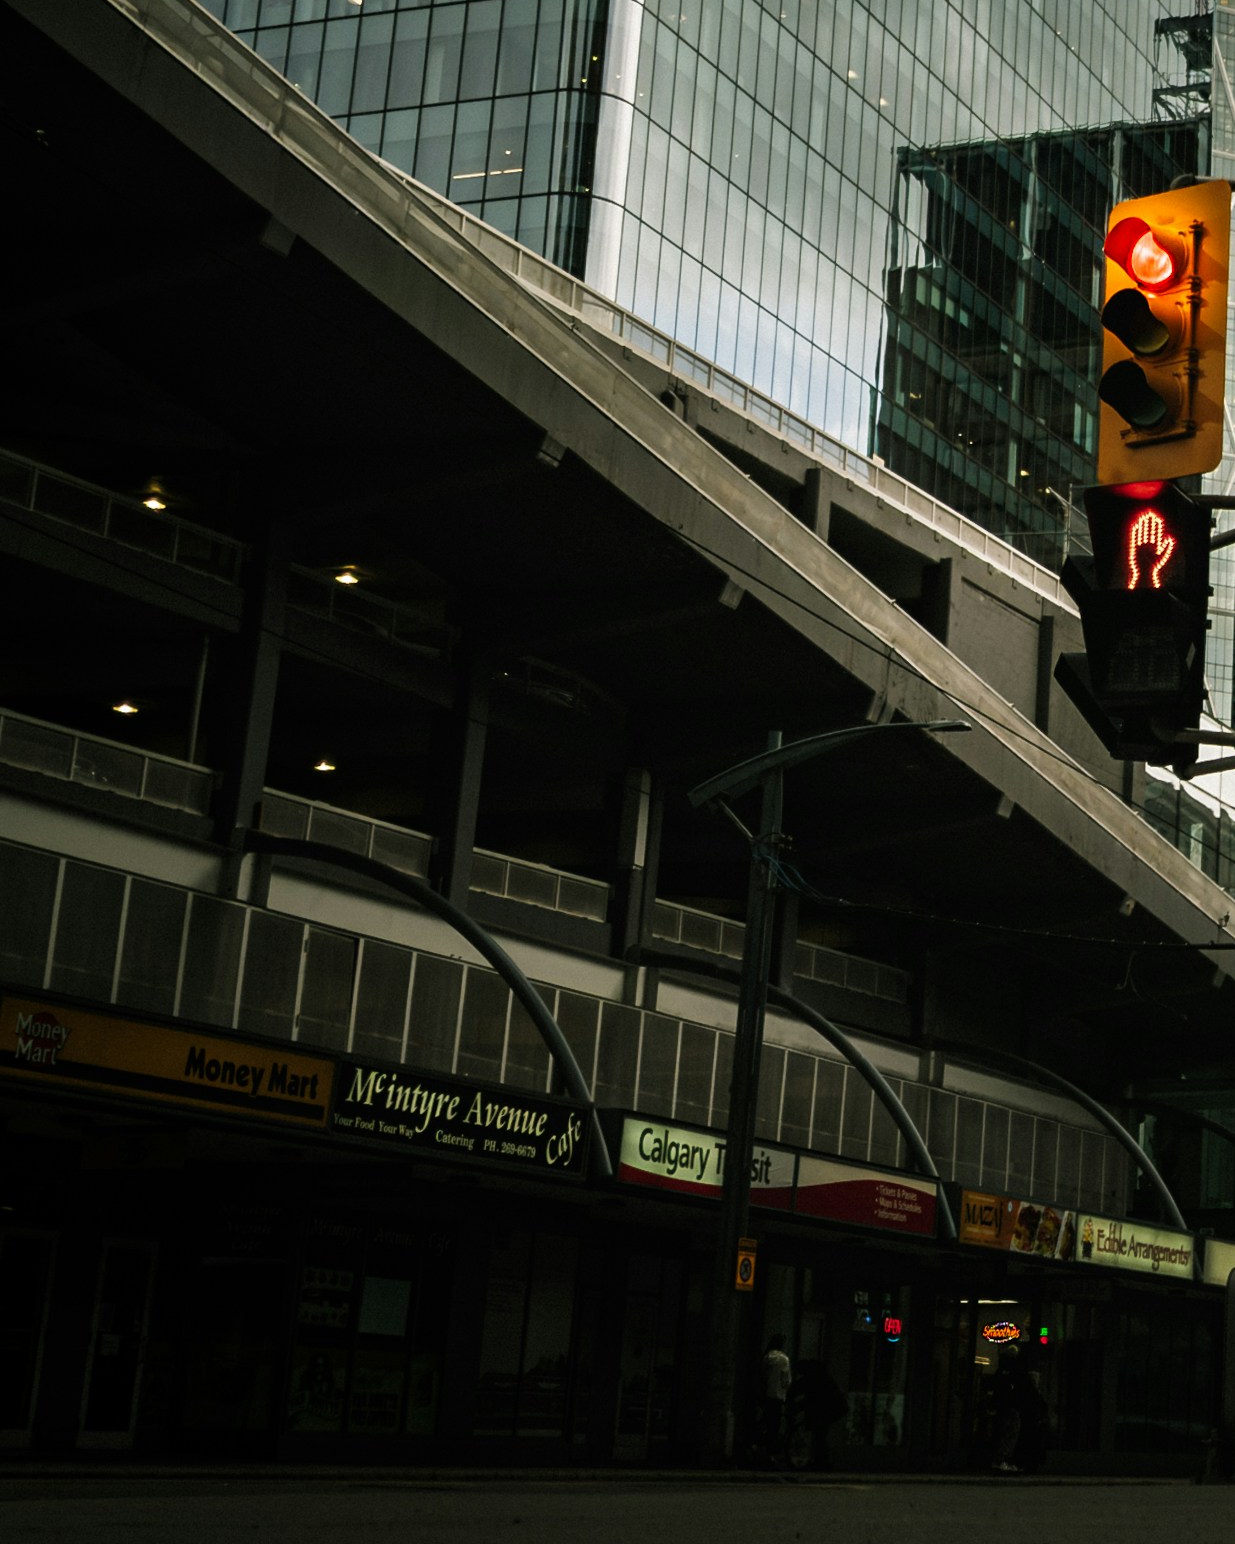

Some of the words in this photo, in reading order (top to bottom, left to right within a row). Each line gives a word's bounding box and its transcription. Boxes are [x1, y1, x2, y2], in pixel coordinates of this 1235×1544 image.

[16, 1011, 70, 1050] Money
[15, 1036, 58, 1066] Mart
[185, 1047, 264, 1097] Money
[268, 1062, 319, 1099] Mart
[333, 1113, 355, 1127] Your
[355, 1117, 375, 1132] Food
[378, 1121, 398, 1136] Your
[435, 1129, 475, 1151] Catering
[462, 1092, 549, 1137] Avenue
[545, 1112, 582, 1166] Cafe
[639, 1127, 710, 1181] Calgary
[715, 1142, 772, 1185] Tsit
[1097, 1222, 1127, 1255] Edible
[1128, 1234, 1190, 1271] Arrangements
[983, 1325, 1020, 1338] Smoothies
